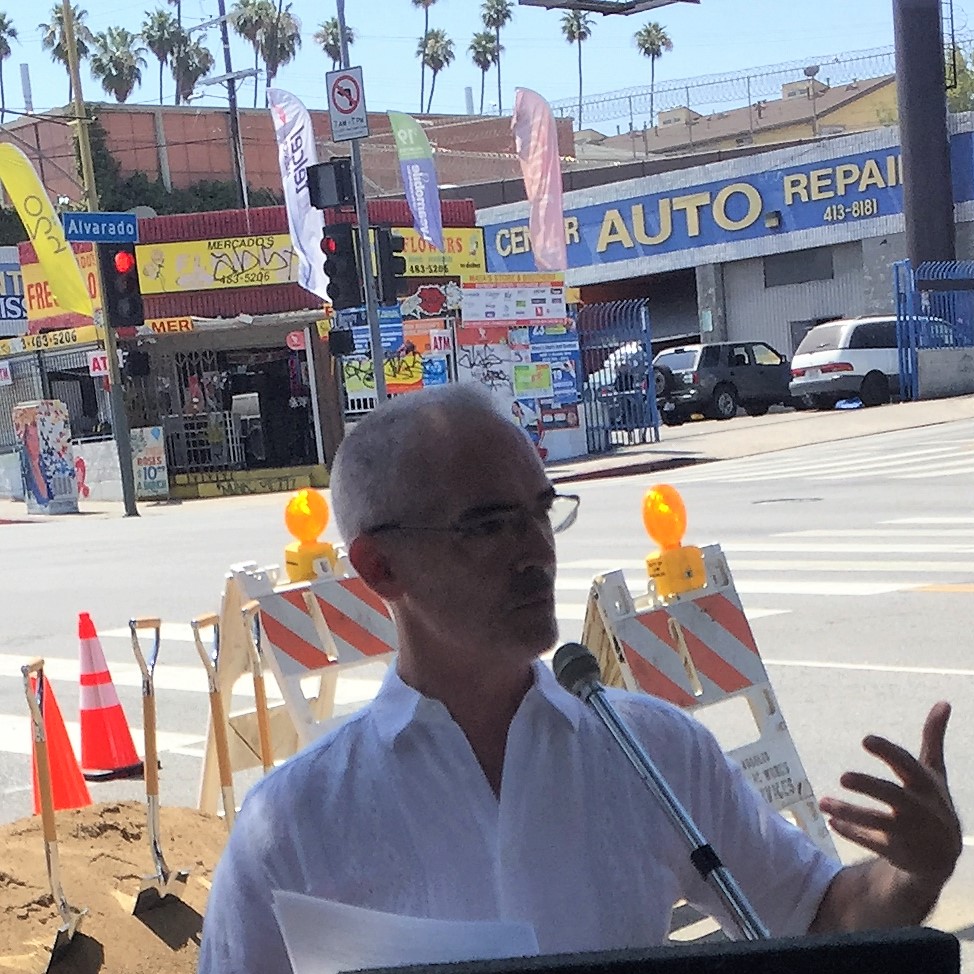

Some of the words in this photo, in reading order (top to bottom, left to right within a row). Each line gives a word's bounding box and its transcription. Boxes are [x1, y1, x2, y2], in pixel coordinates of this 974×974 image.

[823, 198, 877, 222] 413-8181
[68, 219, 135, 236] Alvarado
[495, 216, 579, 257] CENR
[596, 182, 763, 253] AUTO
[403, 237, 463, 254] FLORS
[151, 319, 190, 333] MER
[433, 336, 451, 350] ATM
[92, 356, 108, 372] AT
